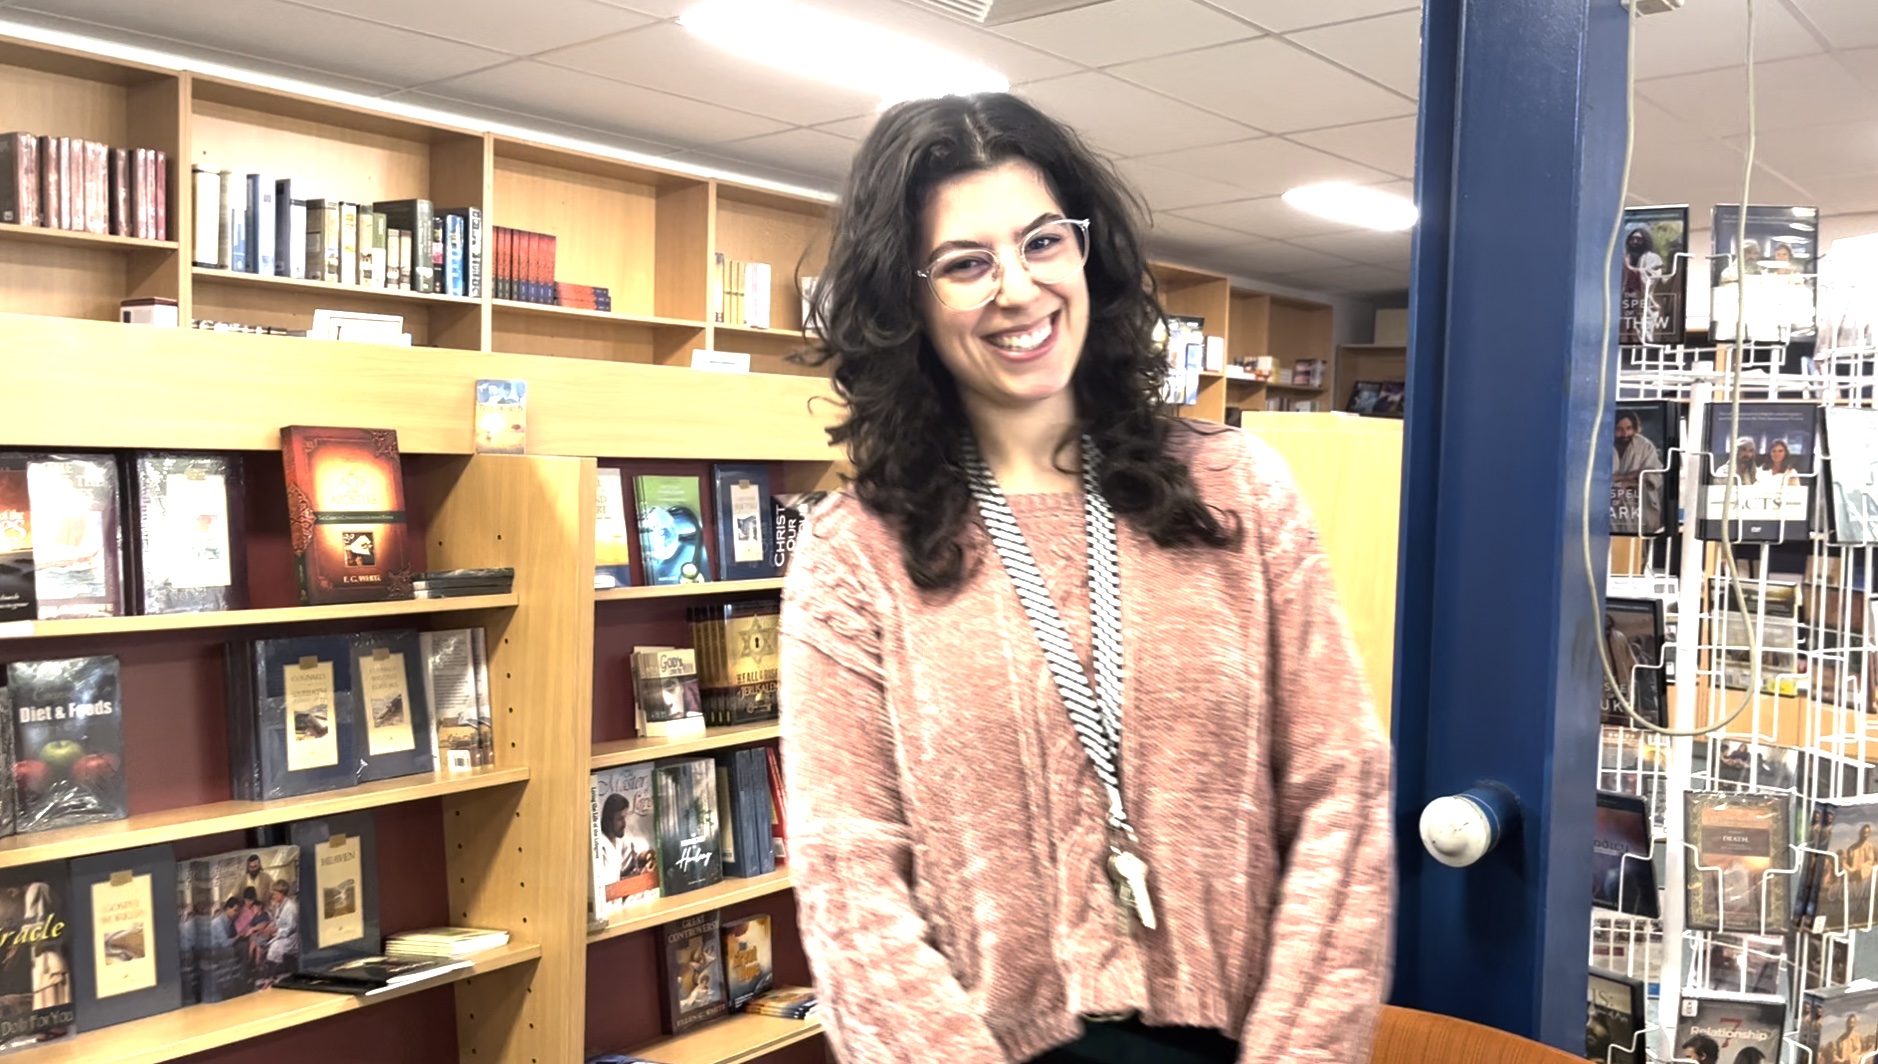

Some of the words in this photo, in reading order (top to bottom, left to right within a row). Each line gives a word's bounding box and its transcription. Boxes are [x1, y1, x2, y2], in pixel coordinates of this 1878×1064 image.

[774, 503, 787, 568] CHRIST
[786, 518, 798, 552] OUR
[19, 705, 51, 724] Diet
[54, 705, 66, 720] &
[68, 699, 113, 718] Foods
[320, 850, 356, 867] HEAVEN
[49, 1009, 74, 1026] You
[1690, 1025, 1769, 1042] Relationship
